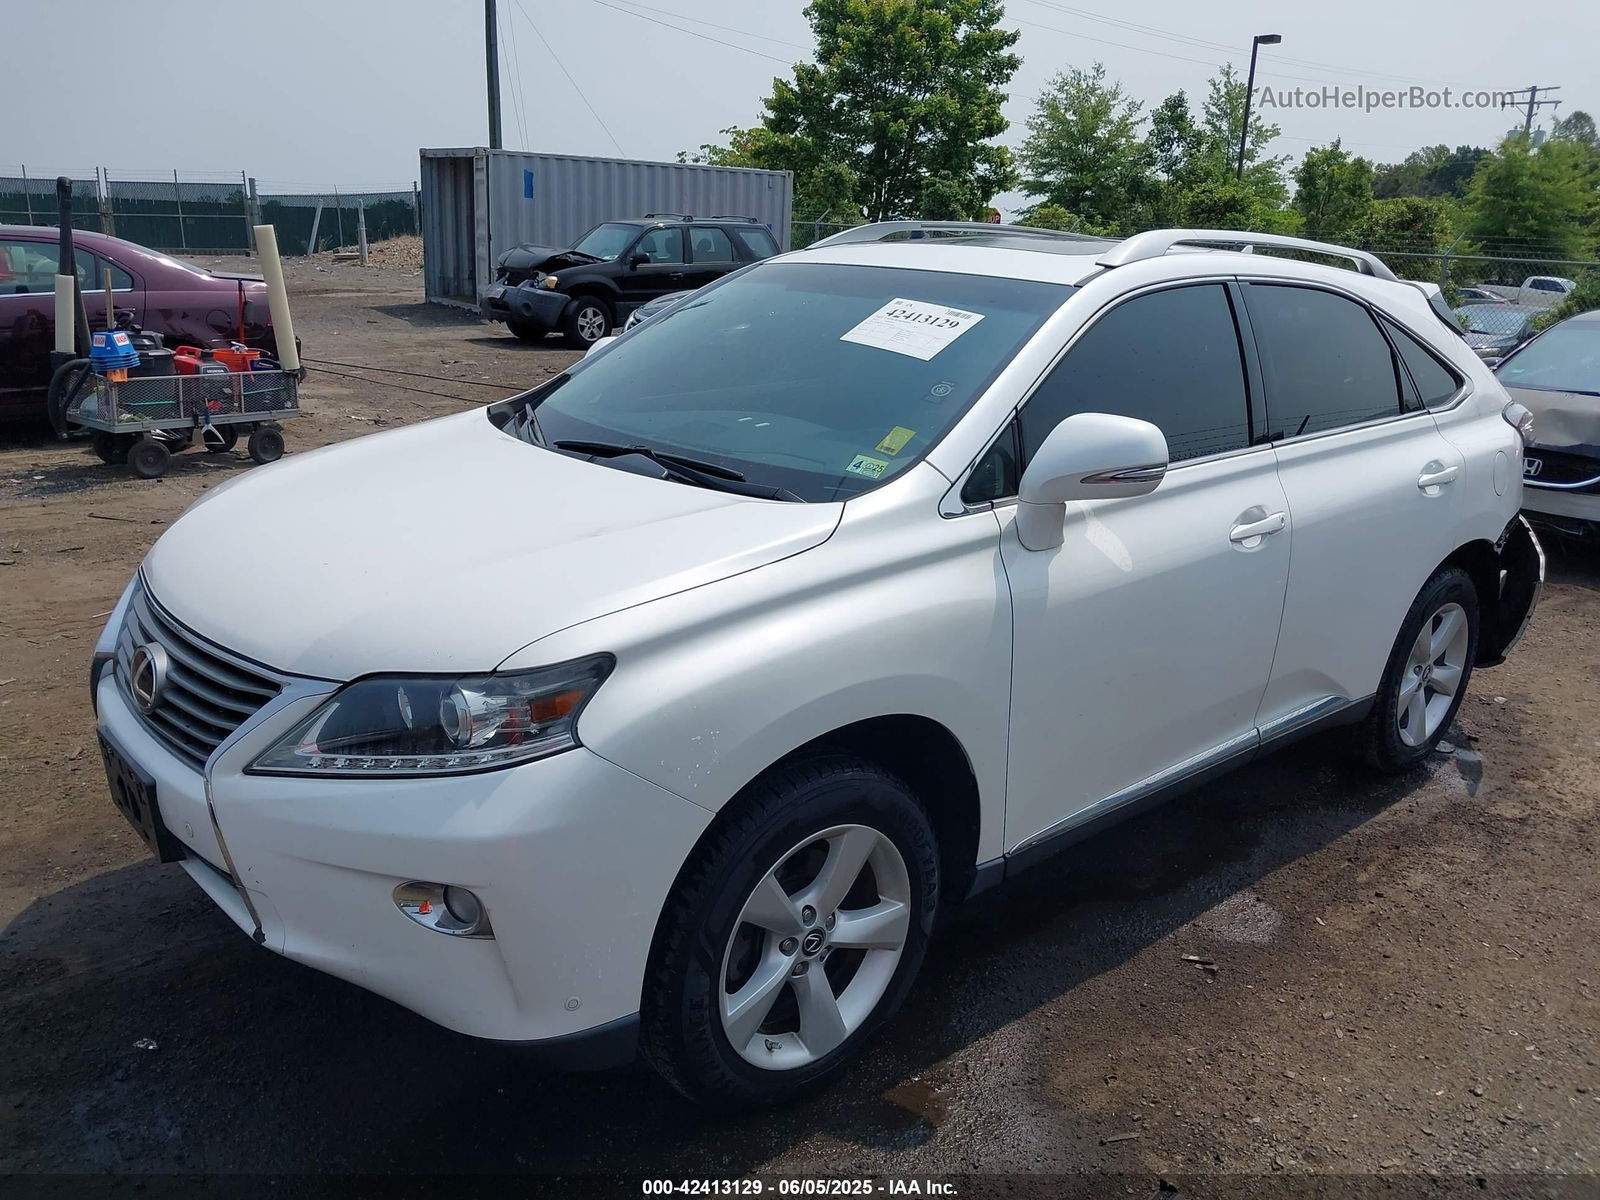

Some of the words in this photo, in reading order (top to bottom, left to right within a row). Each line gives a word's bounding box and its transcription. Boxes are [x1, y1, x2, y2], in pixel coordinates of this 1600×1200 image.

[886, 308, 960, 329] 42413129
[852, 460, 864, 470] 4
[872, 464, 885, 473] 25
